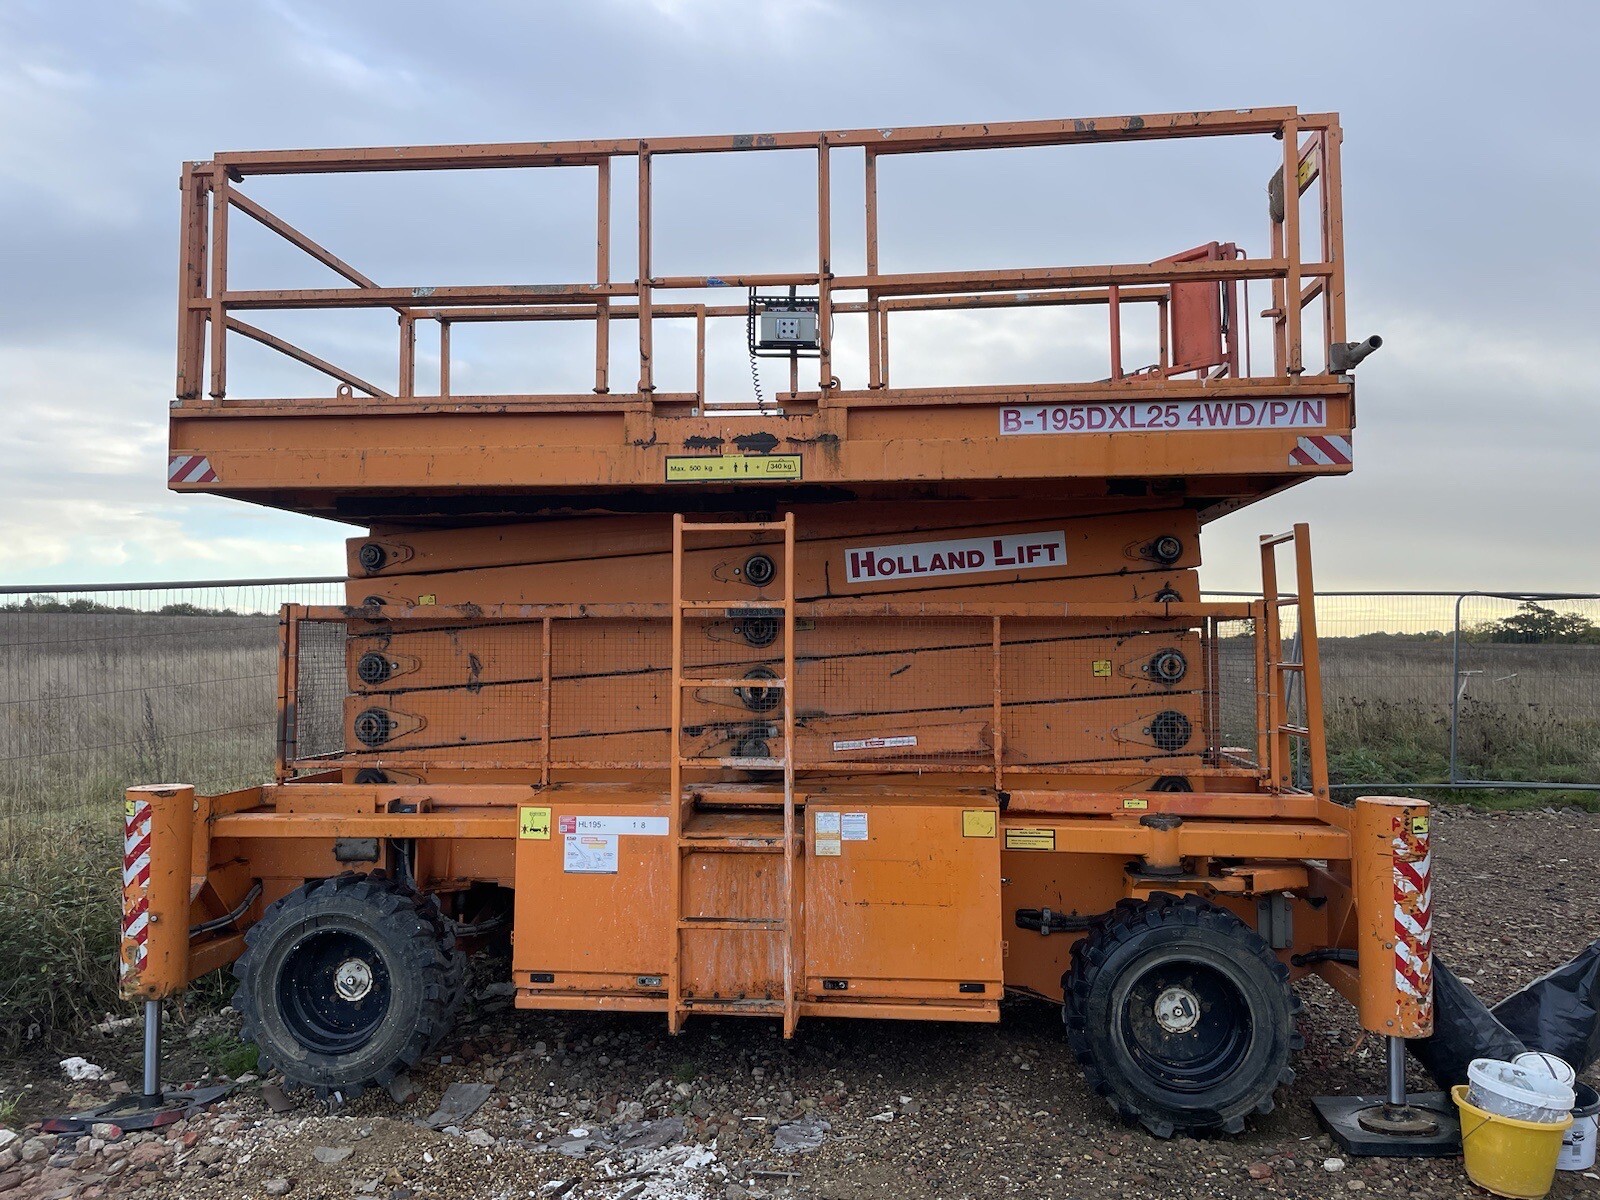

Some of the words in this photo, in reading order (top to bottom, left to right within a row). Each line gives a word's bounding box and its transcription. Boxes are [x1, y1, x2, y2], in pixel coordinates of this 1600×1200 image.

[1003, 405, 1180, 432] B-195DXL25
[1187, 401, 1324, 427] 4WD/P/N
[850, 549, 985, 578] HOLLAND
[993, 540, 1060, 566] LIFT
